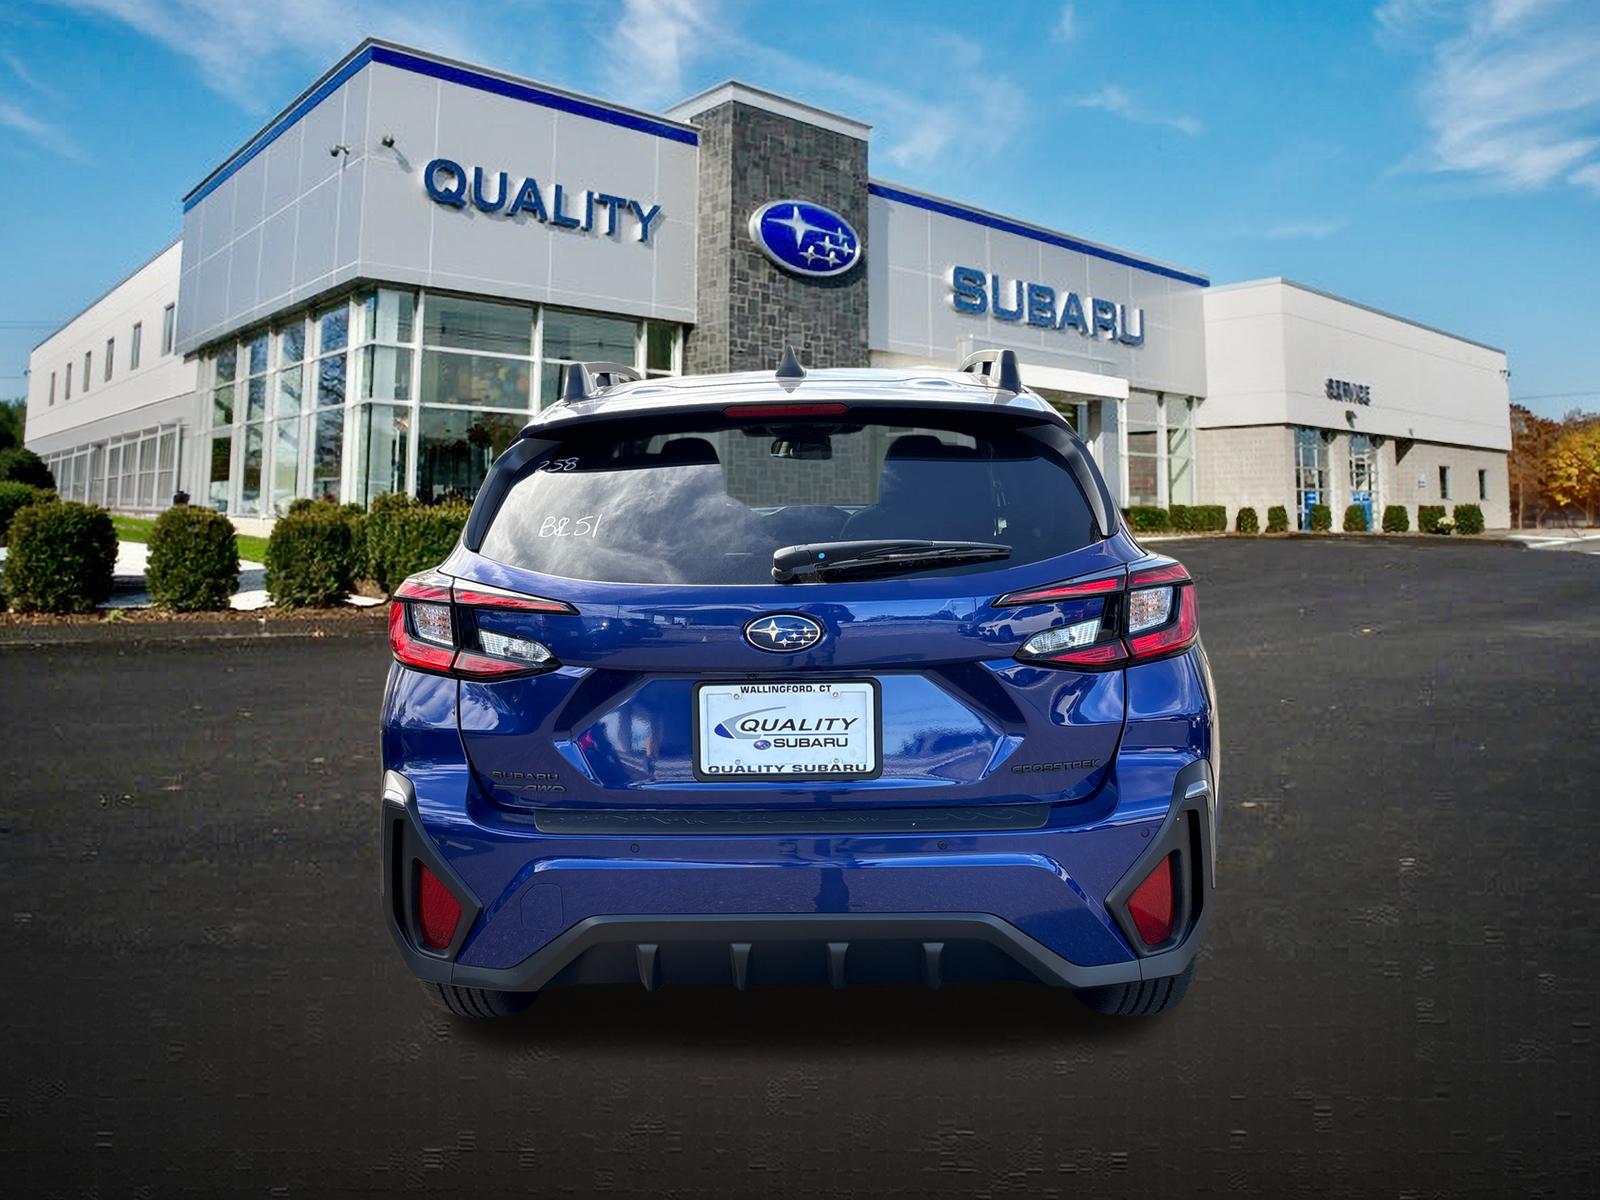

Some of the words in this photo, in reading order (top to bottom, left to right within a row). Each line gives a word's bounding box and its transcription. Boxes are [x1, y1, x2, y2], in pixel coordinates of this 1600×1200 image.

[424, 158, 661, 242] QUALITY
[949, 265, 1145, 346] SUBARU
[740, 718, 858, 732] QUALITY
[774, 738, 848, 748] SUBARU
[708, 764, 785, 773] QUALITY
[792, 764, 867, 772] SUBARU
[1011, 759, 1100, 773] CROSSTREK
[492, 771, 560, 780] SUBARU
[520, 784, 567, 792] AWD
